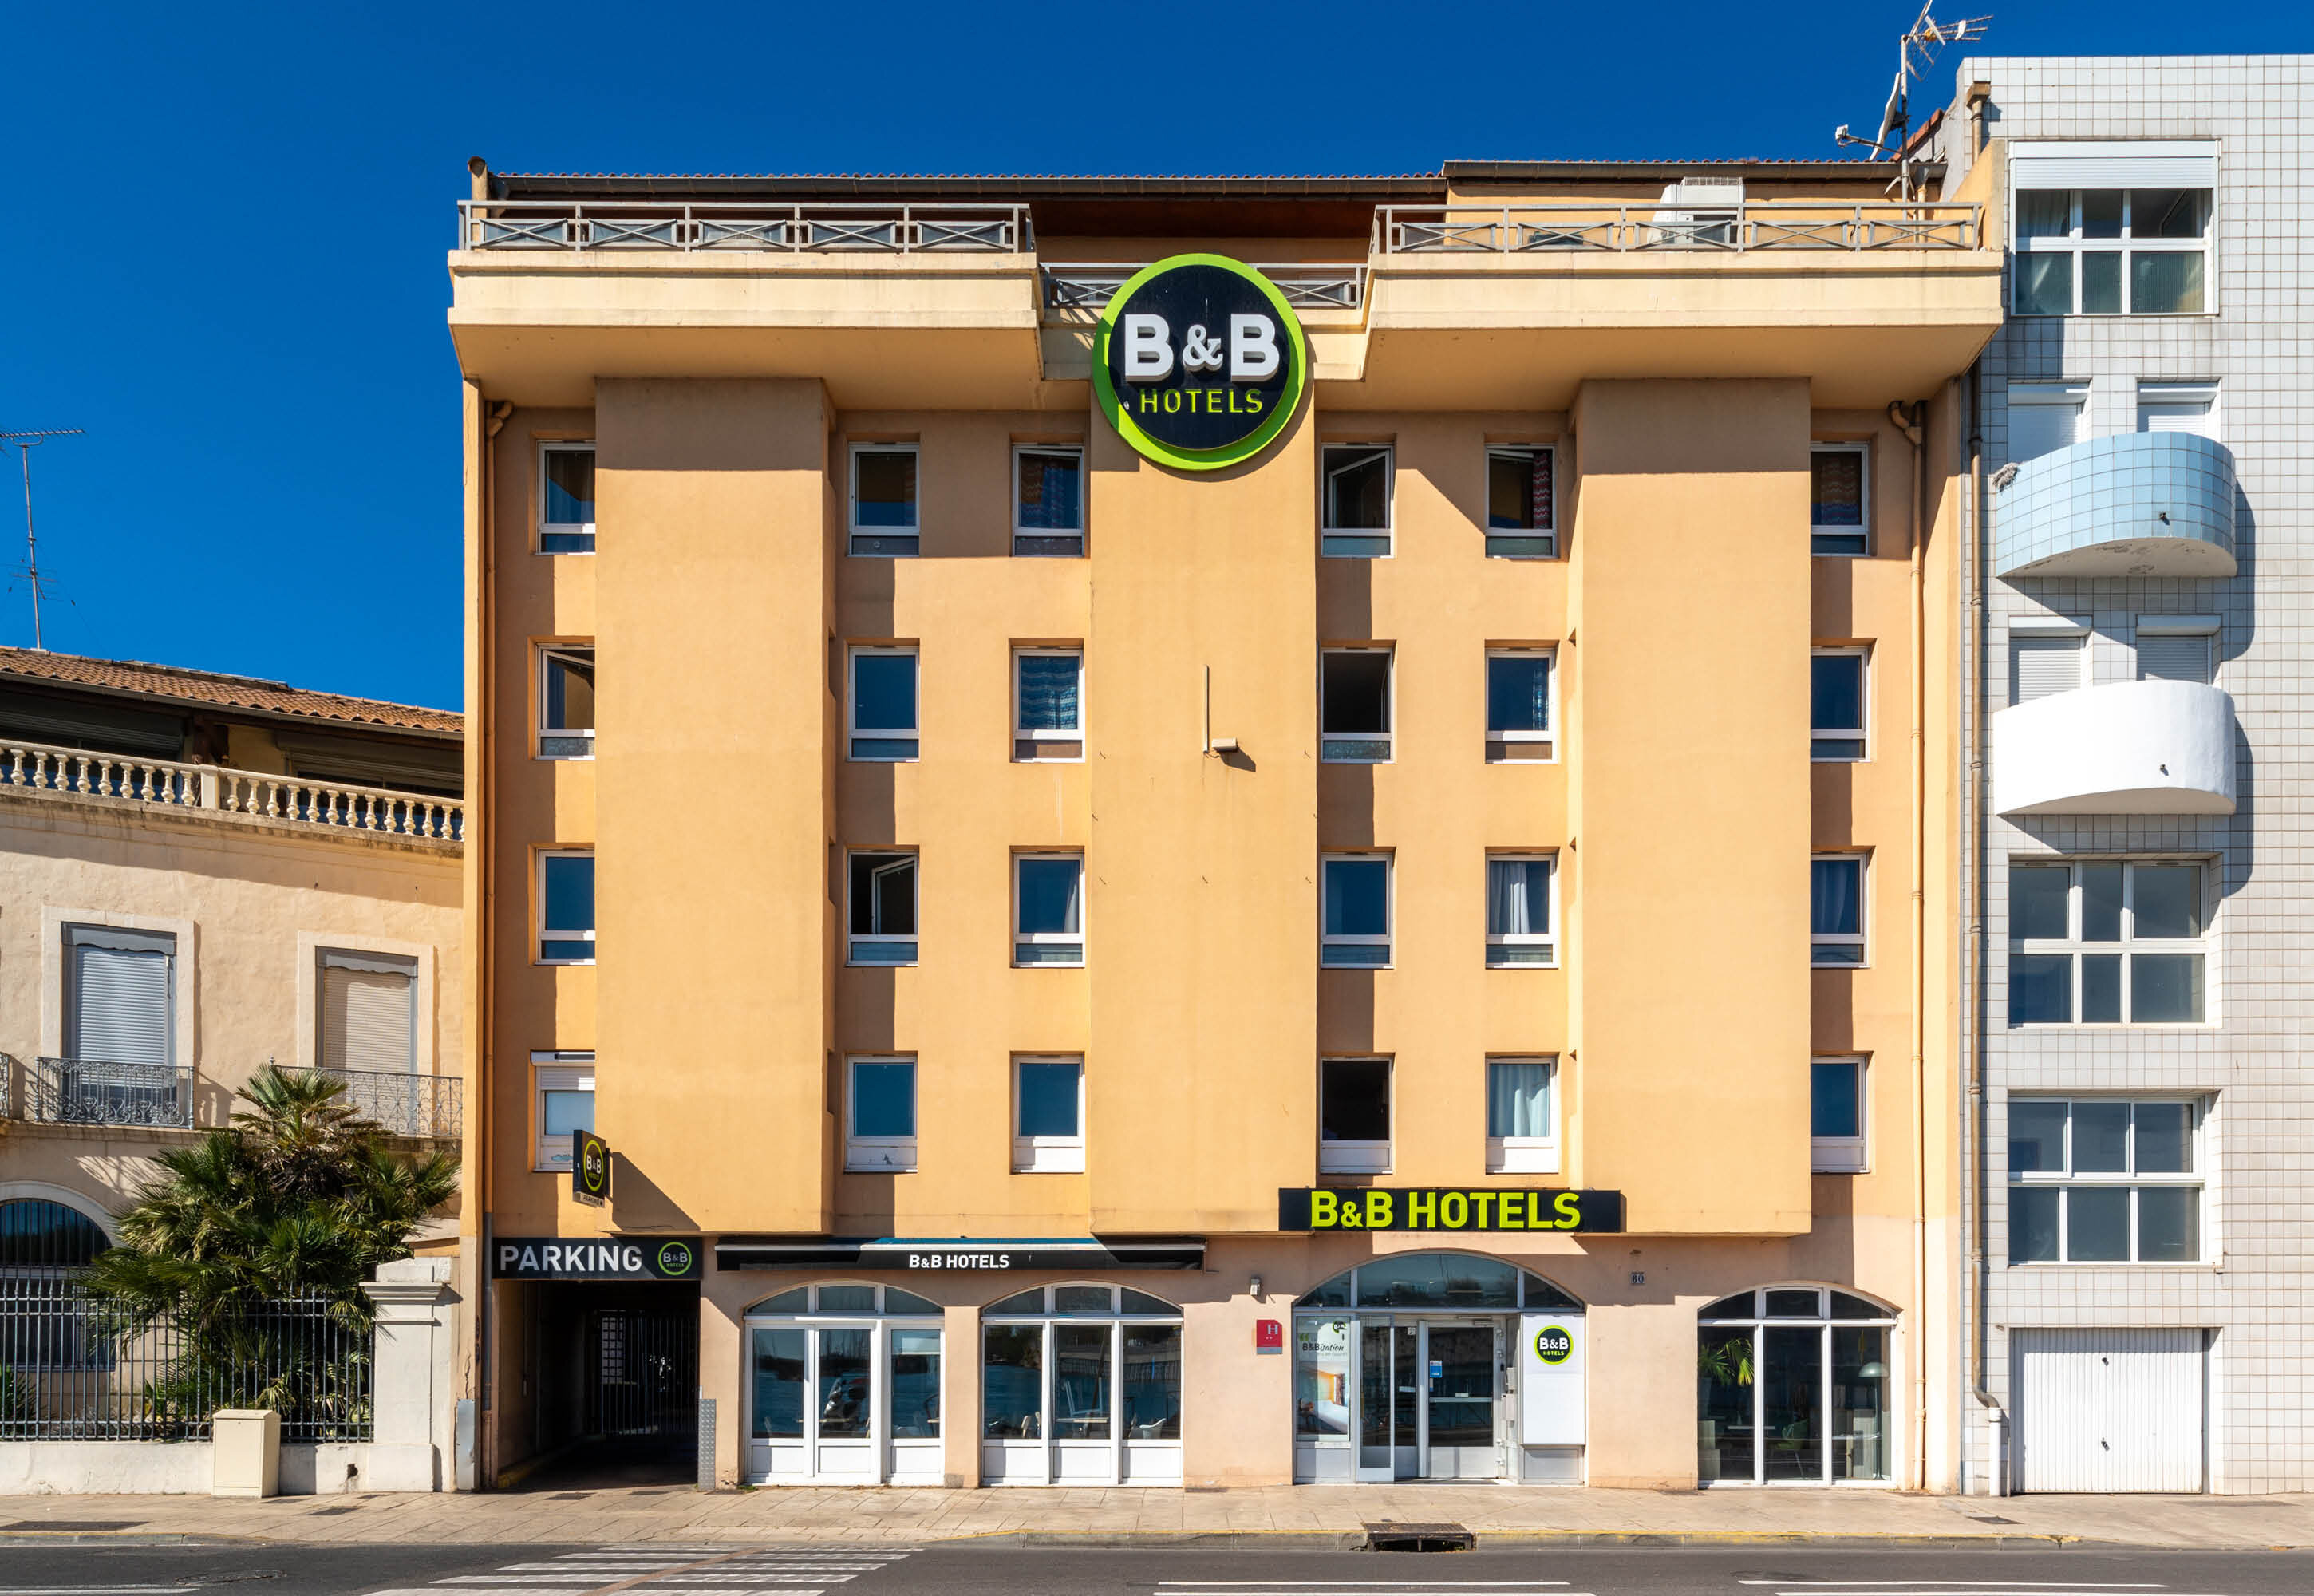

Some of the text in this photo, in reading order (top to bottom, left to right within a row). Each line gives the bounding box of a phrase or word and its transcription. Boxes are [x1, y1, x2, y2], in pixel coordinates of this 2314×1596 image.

[1125, 313, 1280, 382] B&B
[1139, 388, 1264, 413] HOTELS
[586, 1154, 602, 1174] B&B
[1310, 1191, 1581, 1229] B&B HOTELS
[500, 1245, 643, 1272] PARKING
[663, 1252, 688, 1262] B&B
[909, 1254, 1009, 1268] B&B HOTELS
[1267, 1325, 1278, 1335] H
[1539, 1337, 1569, 1350] B&B
